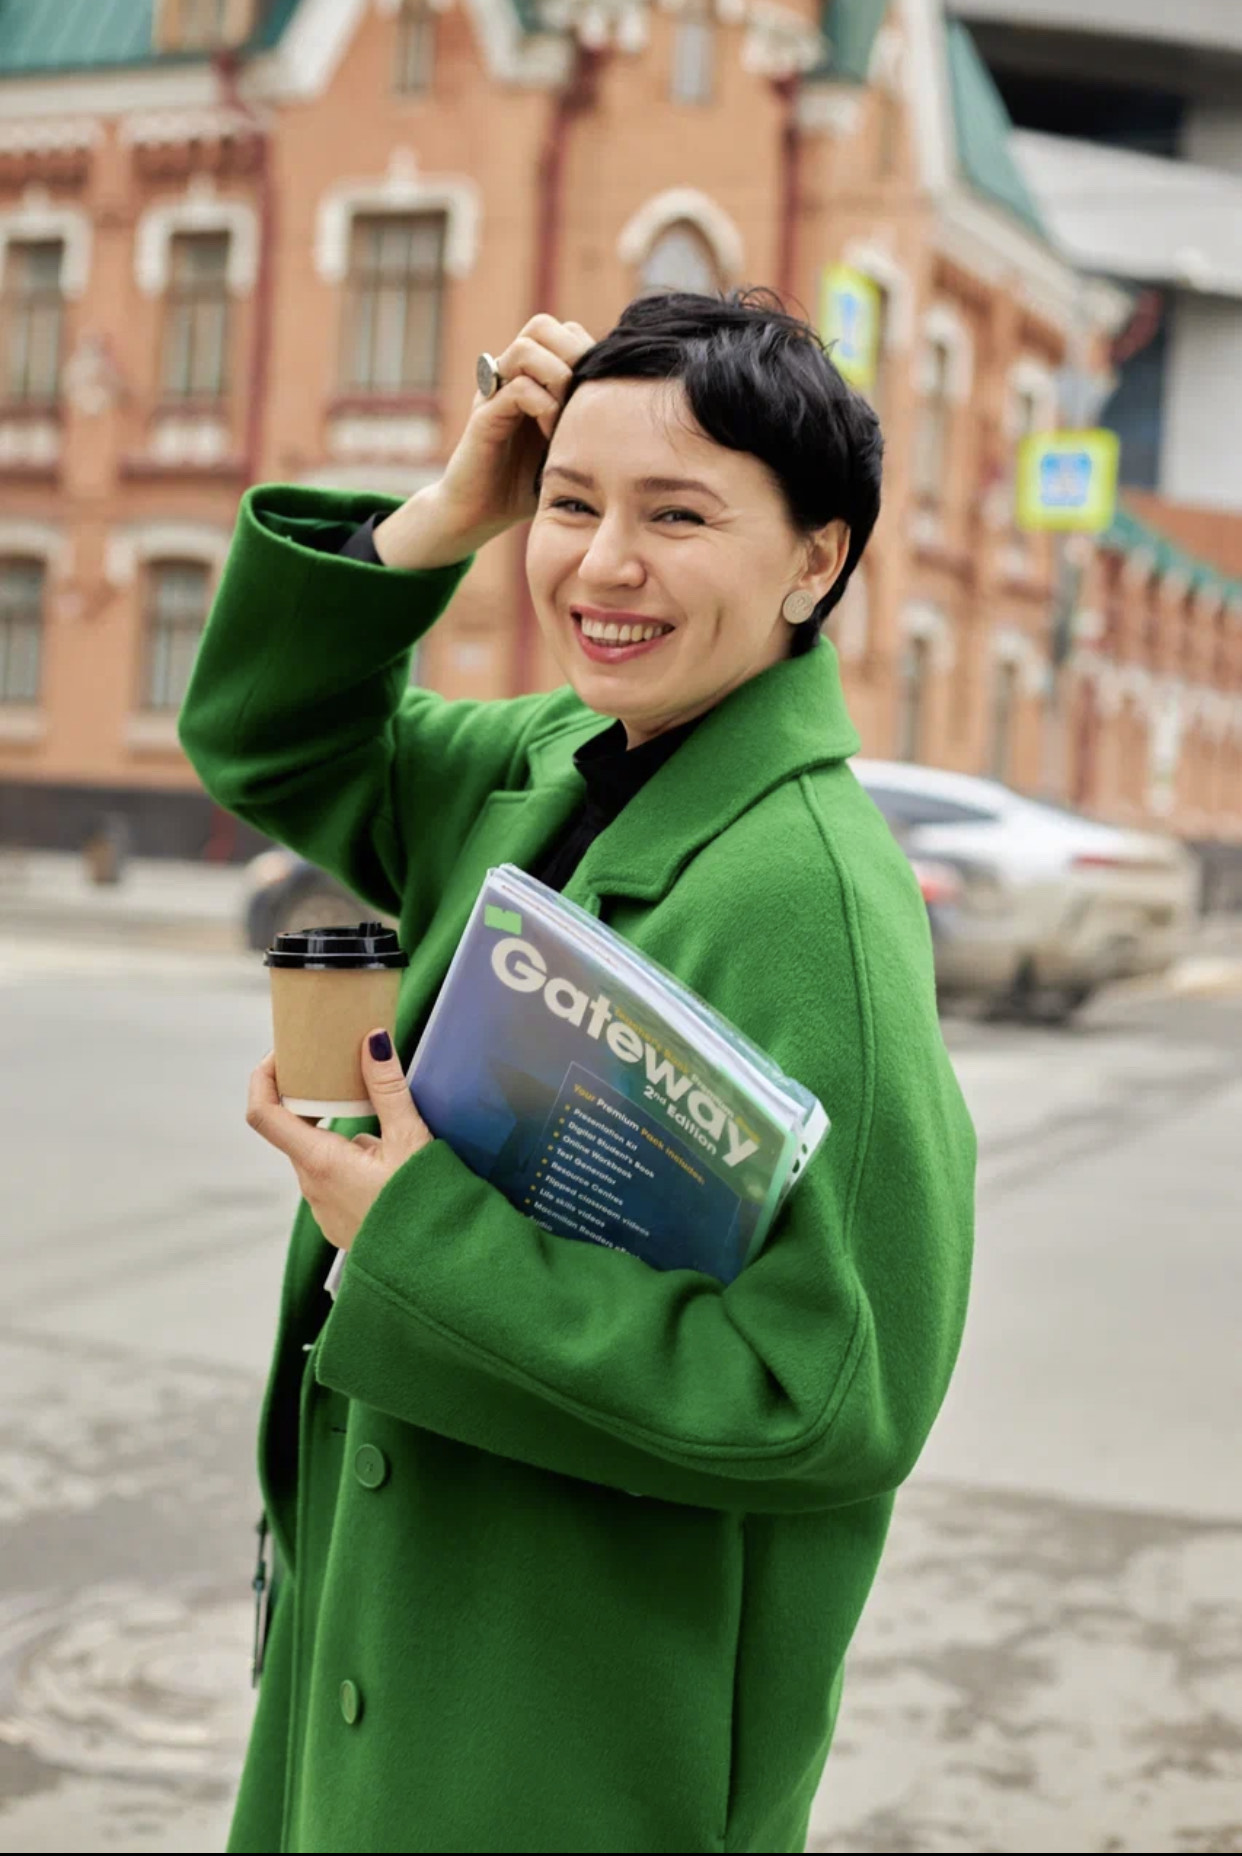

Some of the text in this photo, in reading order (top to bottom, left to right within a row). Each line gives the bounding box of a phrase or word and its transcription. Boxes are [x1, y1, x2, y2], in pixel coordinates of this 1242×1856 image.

[491, 936, 760, 1169] Gateway
[573, 1083, 597, 1101] Your
[596, 1097, 640, 1131] Premium
[640, 1127, 665, 1149] Pack
[573, 1107, 638, 1151] Presentation Kit
[643, 1085, 667, 1105] 2nd
[666, 1104, 718, 1155] Edition
[556, 1147, 617, 1185] Test Generator
[562, 1134, 633, 1179] Online Workbook
[567, 1121, 655, 1178] Digital Student's Book
[544, 1174, 650, 1237] Flipped classroom videos
[550, 1160, 624, 1205] Resource Centres
[533, 1200, 614, 1248] Macmillan Readers
[539, 1187, 606, 1228] Life skills videos
